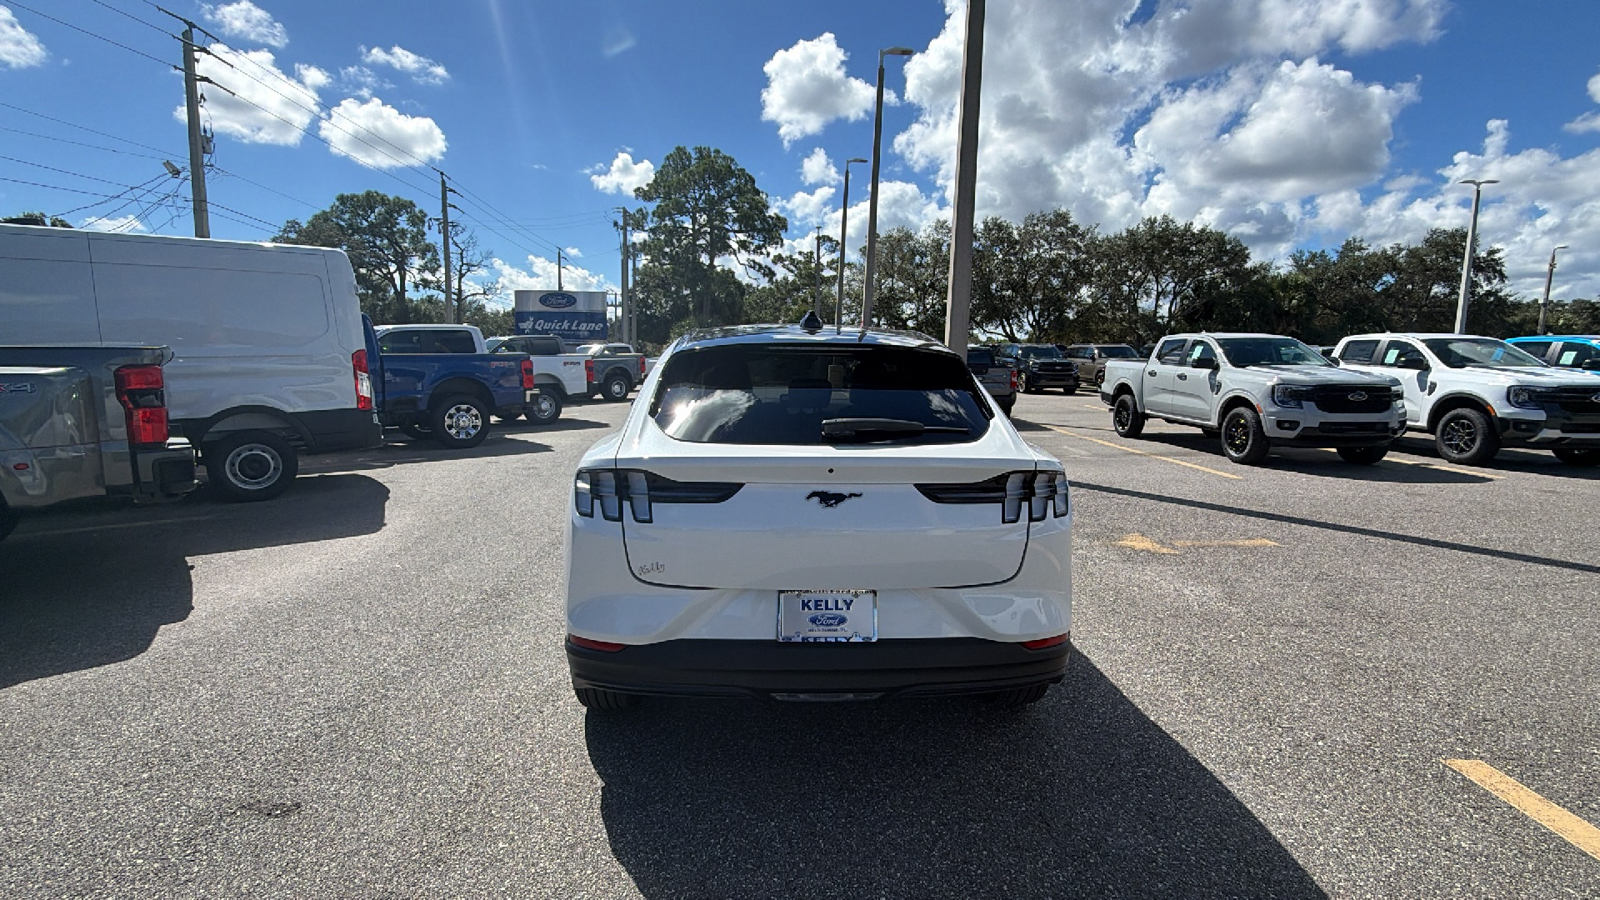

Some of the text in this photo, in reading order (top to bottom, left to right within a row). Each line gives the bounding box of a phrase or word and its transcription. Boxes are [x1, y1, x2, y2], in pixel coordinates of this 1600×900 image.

[546, 295, 568, 304] Ford
[534, 320, 604, 331] Quick Lane
[801, 599, 854, 611] KELLY
[815, 614, 841, 625] Ford
